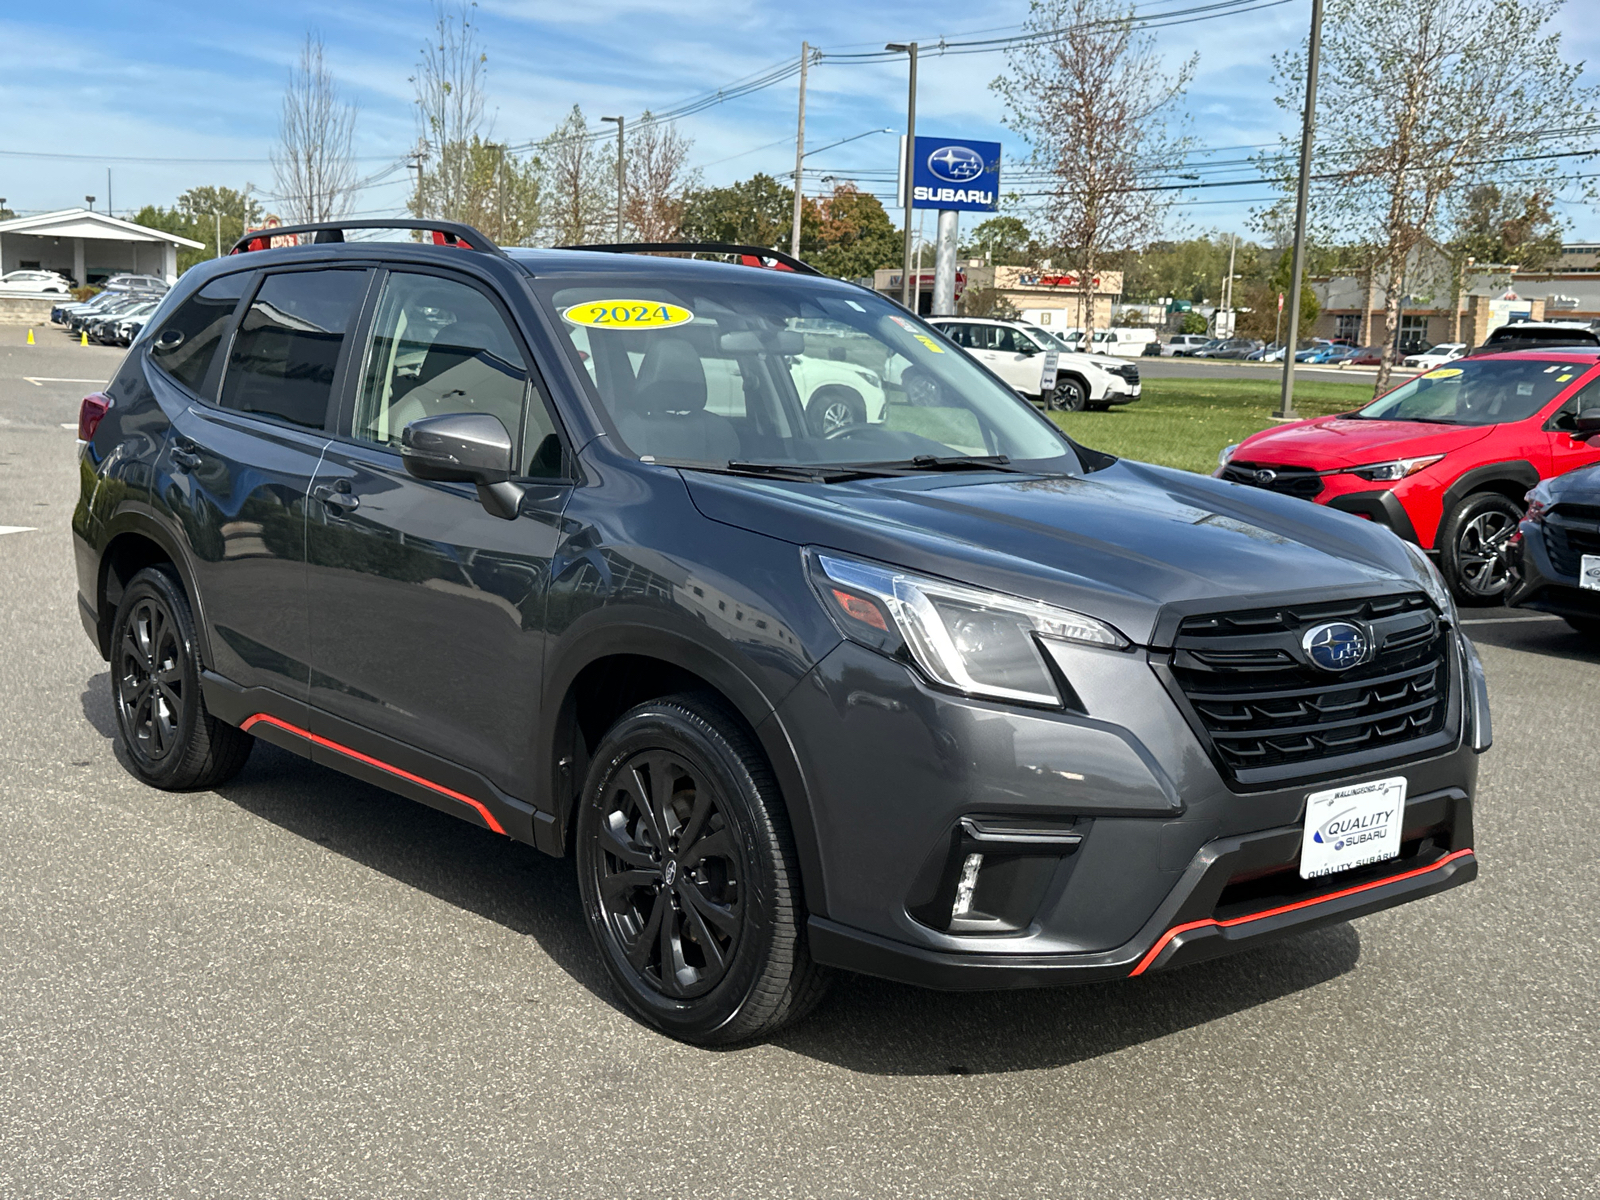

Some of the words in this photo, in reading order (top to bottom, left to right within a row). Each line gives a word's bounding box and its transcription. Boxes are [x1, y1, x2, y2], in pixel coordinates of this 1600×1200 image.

[913, 186, 993, 204] SUBARU
[590, 306, 673, 323] 2024
[1328, 809, 1394, 835] QUALITY
[1345, 829, 1387, 847] SUBARU
[1308, 862, 1353, 879] QUALITY
[1356, 851, 1397, 867] SUBARU
